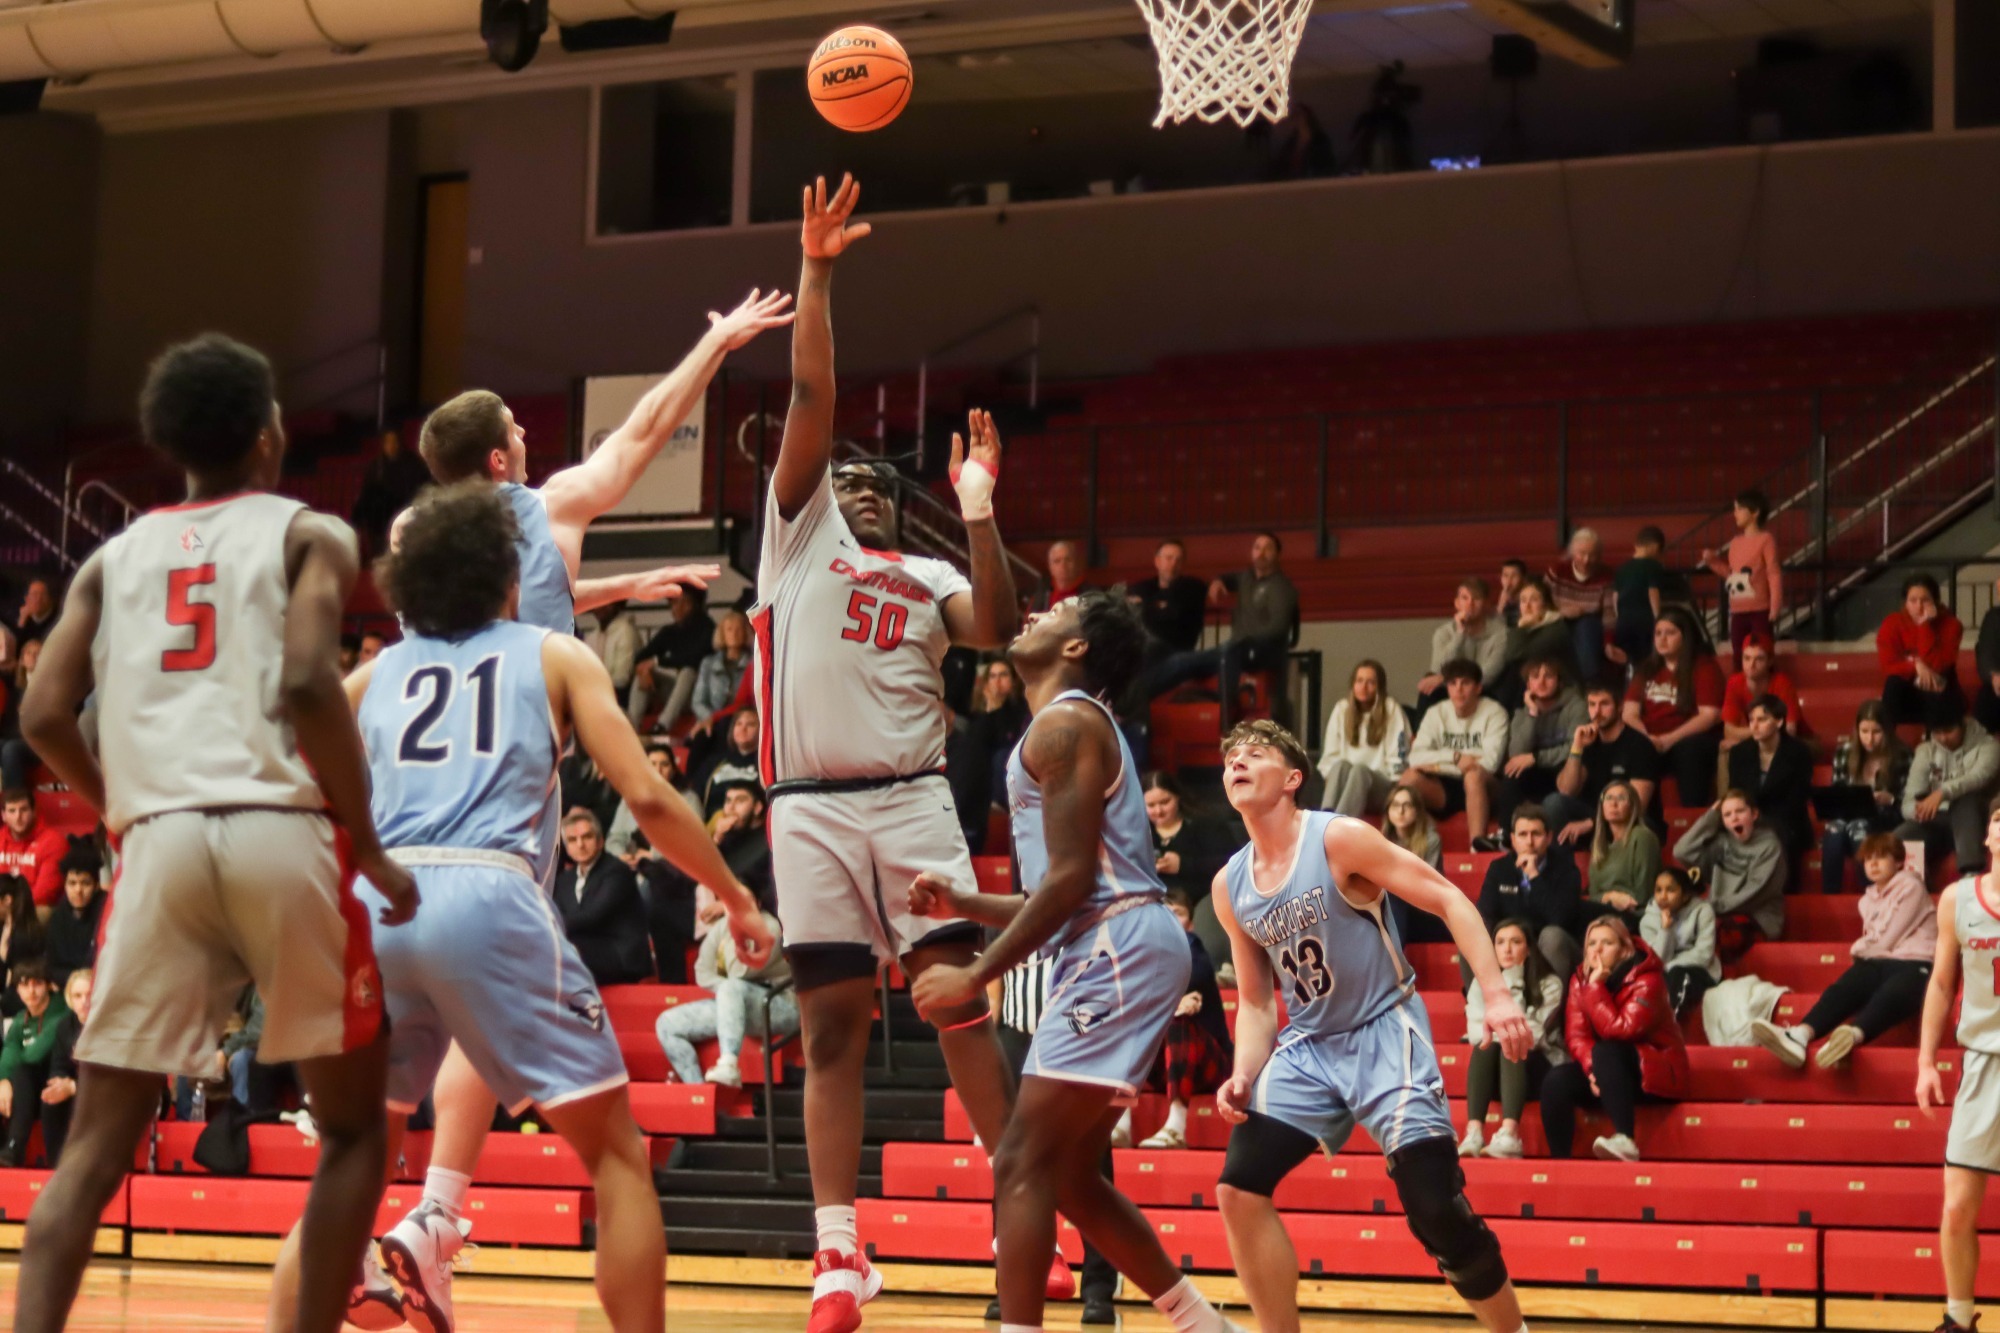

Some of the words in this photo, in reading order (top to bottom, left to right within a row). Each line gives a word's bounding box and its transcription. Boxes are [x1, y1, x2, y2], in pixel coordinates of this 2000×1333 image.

[814, 36, 877, 60] Wilson
[822, 64, 868, 87] NCAA
[161, 562, 217, 672] 5
[841, 588, 908, 651] 50
[396, 651, 505, 768] 21
[1245, 885, 1328, 947] ELMHURST
[1279, 935, 1334, 1006] 13
